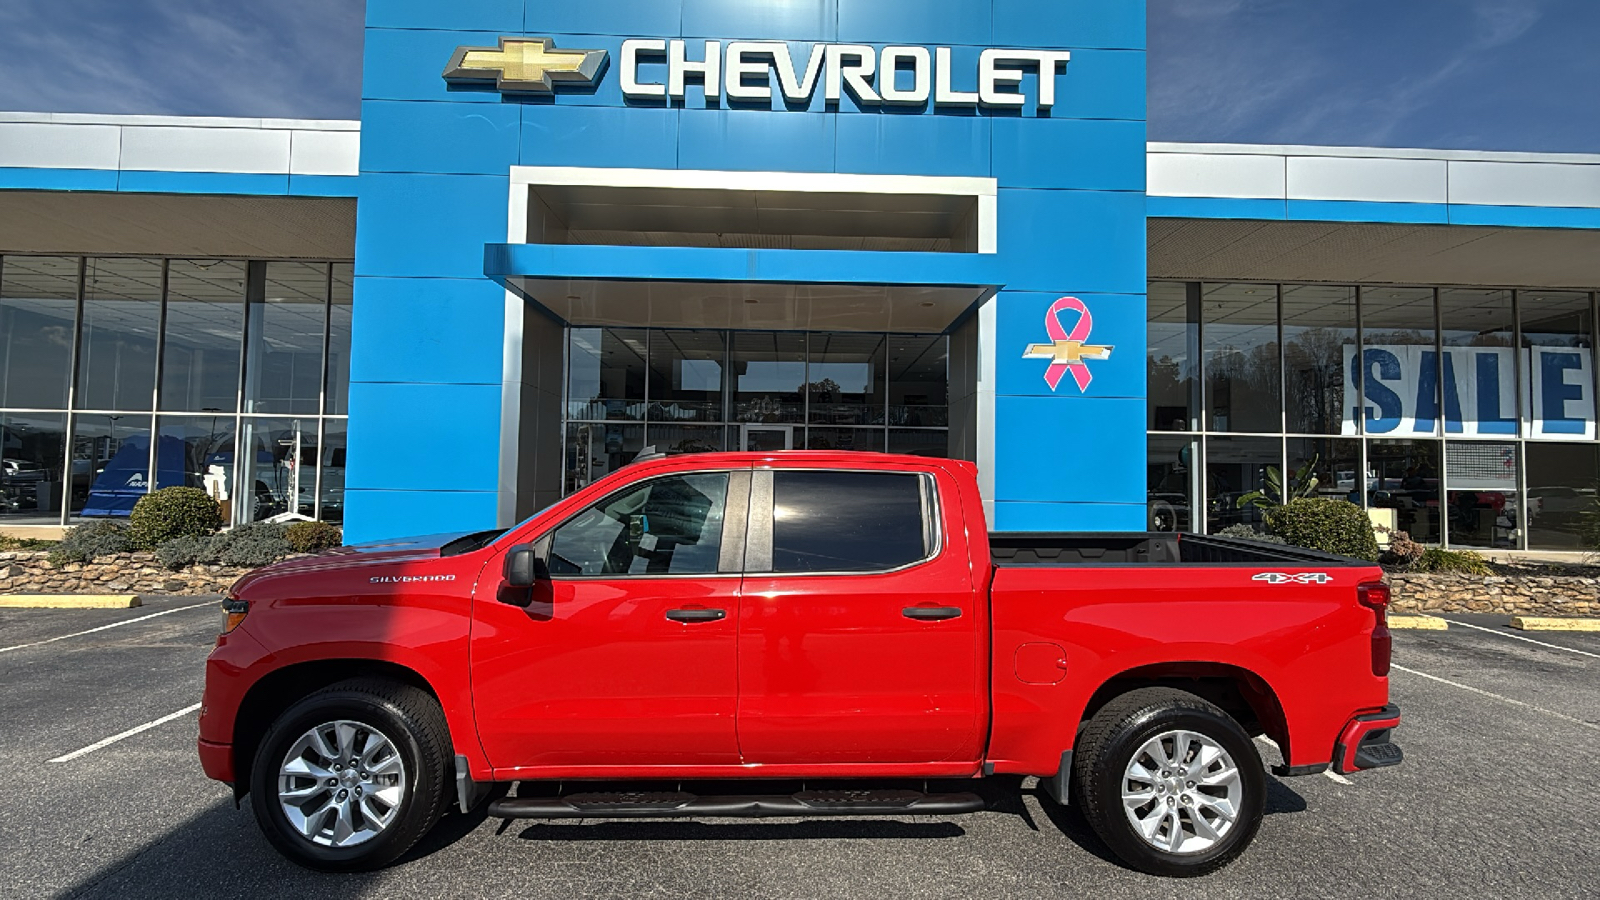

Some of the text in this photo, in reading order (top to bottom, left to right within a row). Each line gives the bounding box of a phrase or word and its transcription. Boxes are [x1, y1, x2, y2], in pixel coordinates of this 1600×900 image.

[620, 38, 1070, 107] CHEVROLET
[1351, 348, 1587, 435] SALE
[370, 574, 456, 583] SILVERADO
